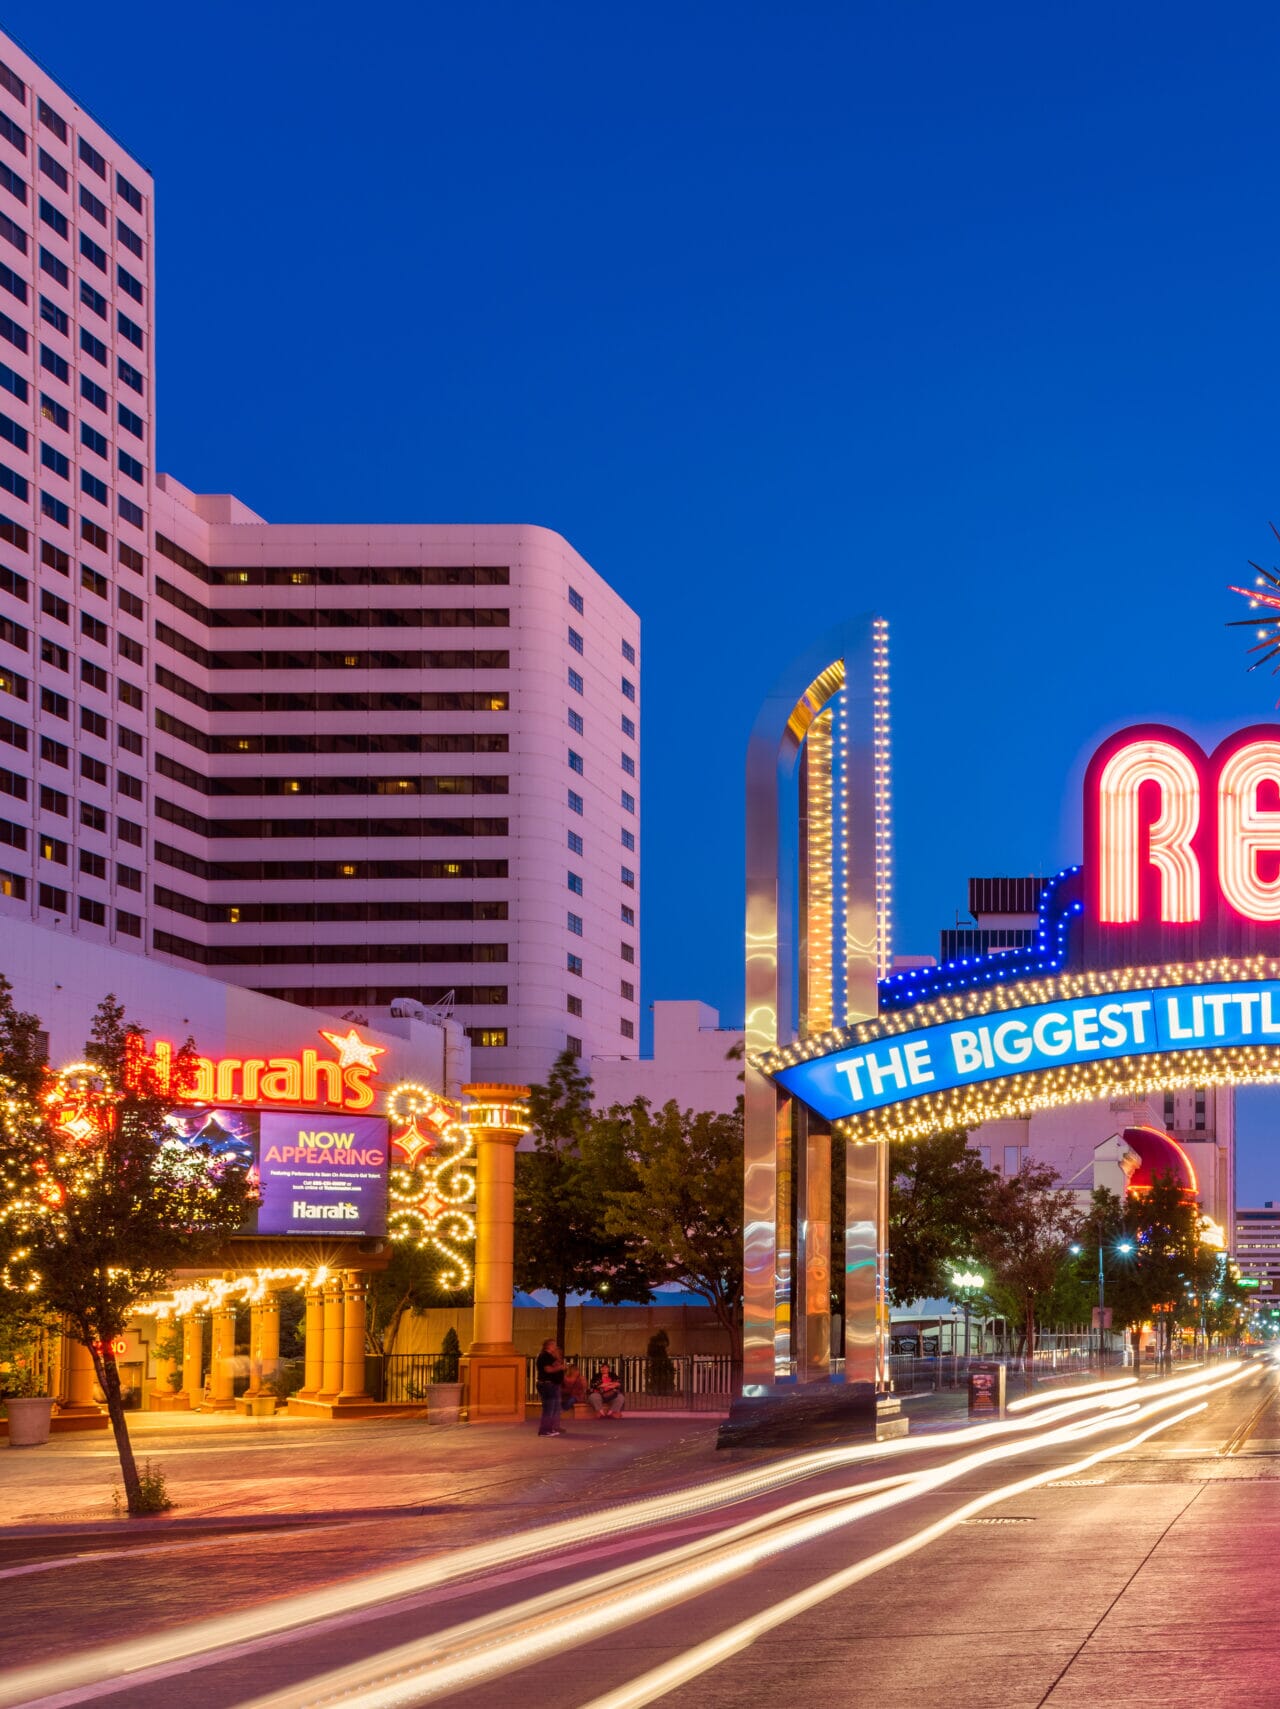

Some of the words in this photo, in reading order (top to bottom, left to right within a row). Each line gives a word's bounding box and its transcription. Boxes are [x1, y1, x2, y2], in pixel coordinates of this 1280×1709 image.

[835, 1039, 934, 1101] THE
[950, 1001, 1151, 1075] BIGGEST
[298, 1130, 355, 1150] NOW
[264, 1145, 385, 1167] APPEARING
